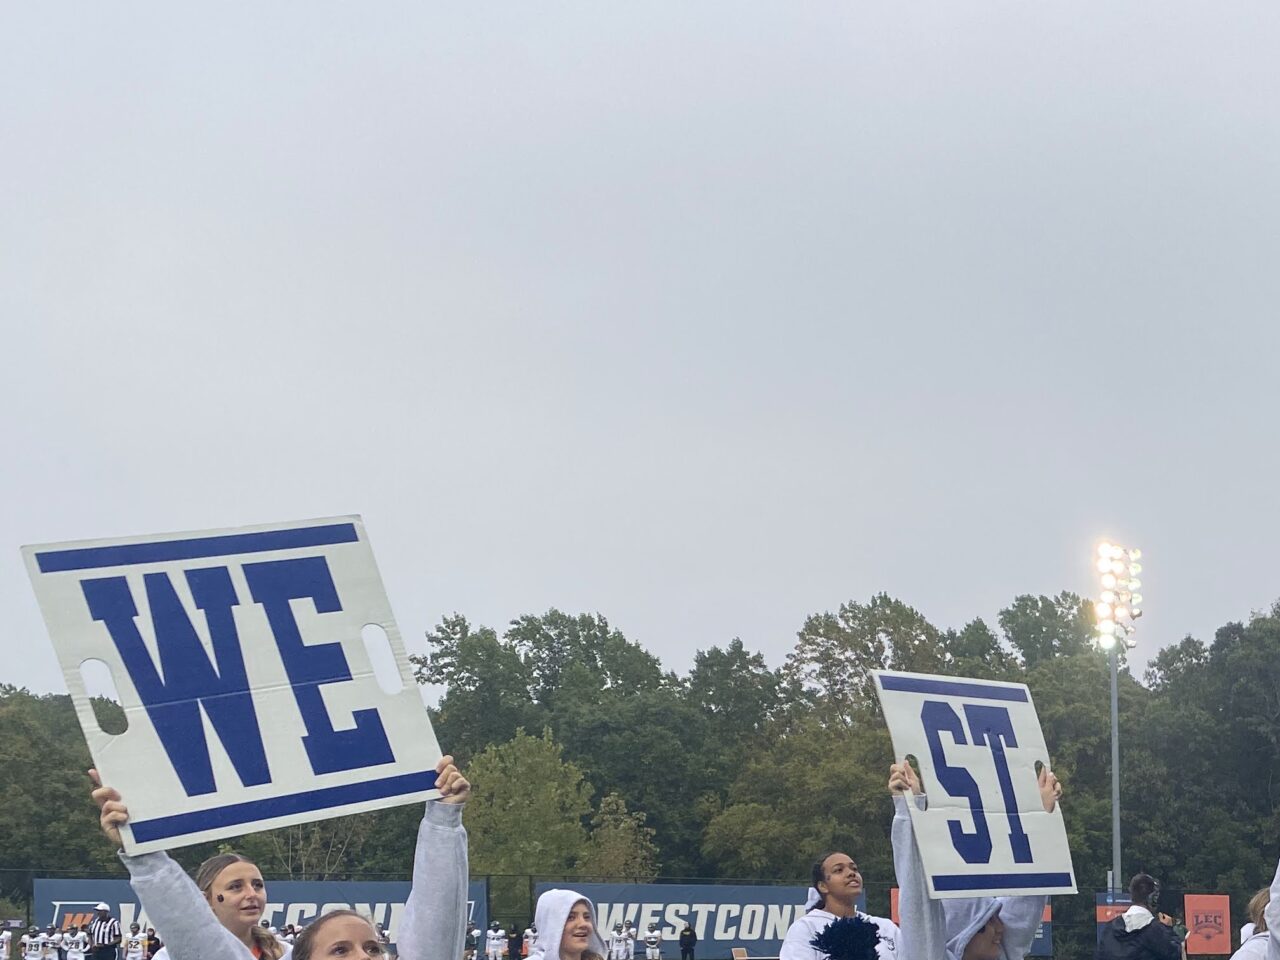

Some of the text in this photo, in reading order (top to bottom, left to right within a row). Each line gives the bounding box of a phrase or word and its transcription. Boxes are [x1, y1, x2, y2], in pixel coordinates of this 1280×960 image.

[80, 556, 396, 797] WE
[921, 700, 1034, 864] ST
[1194, 914, 1222, 927] LEC
